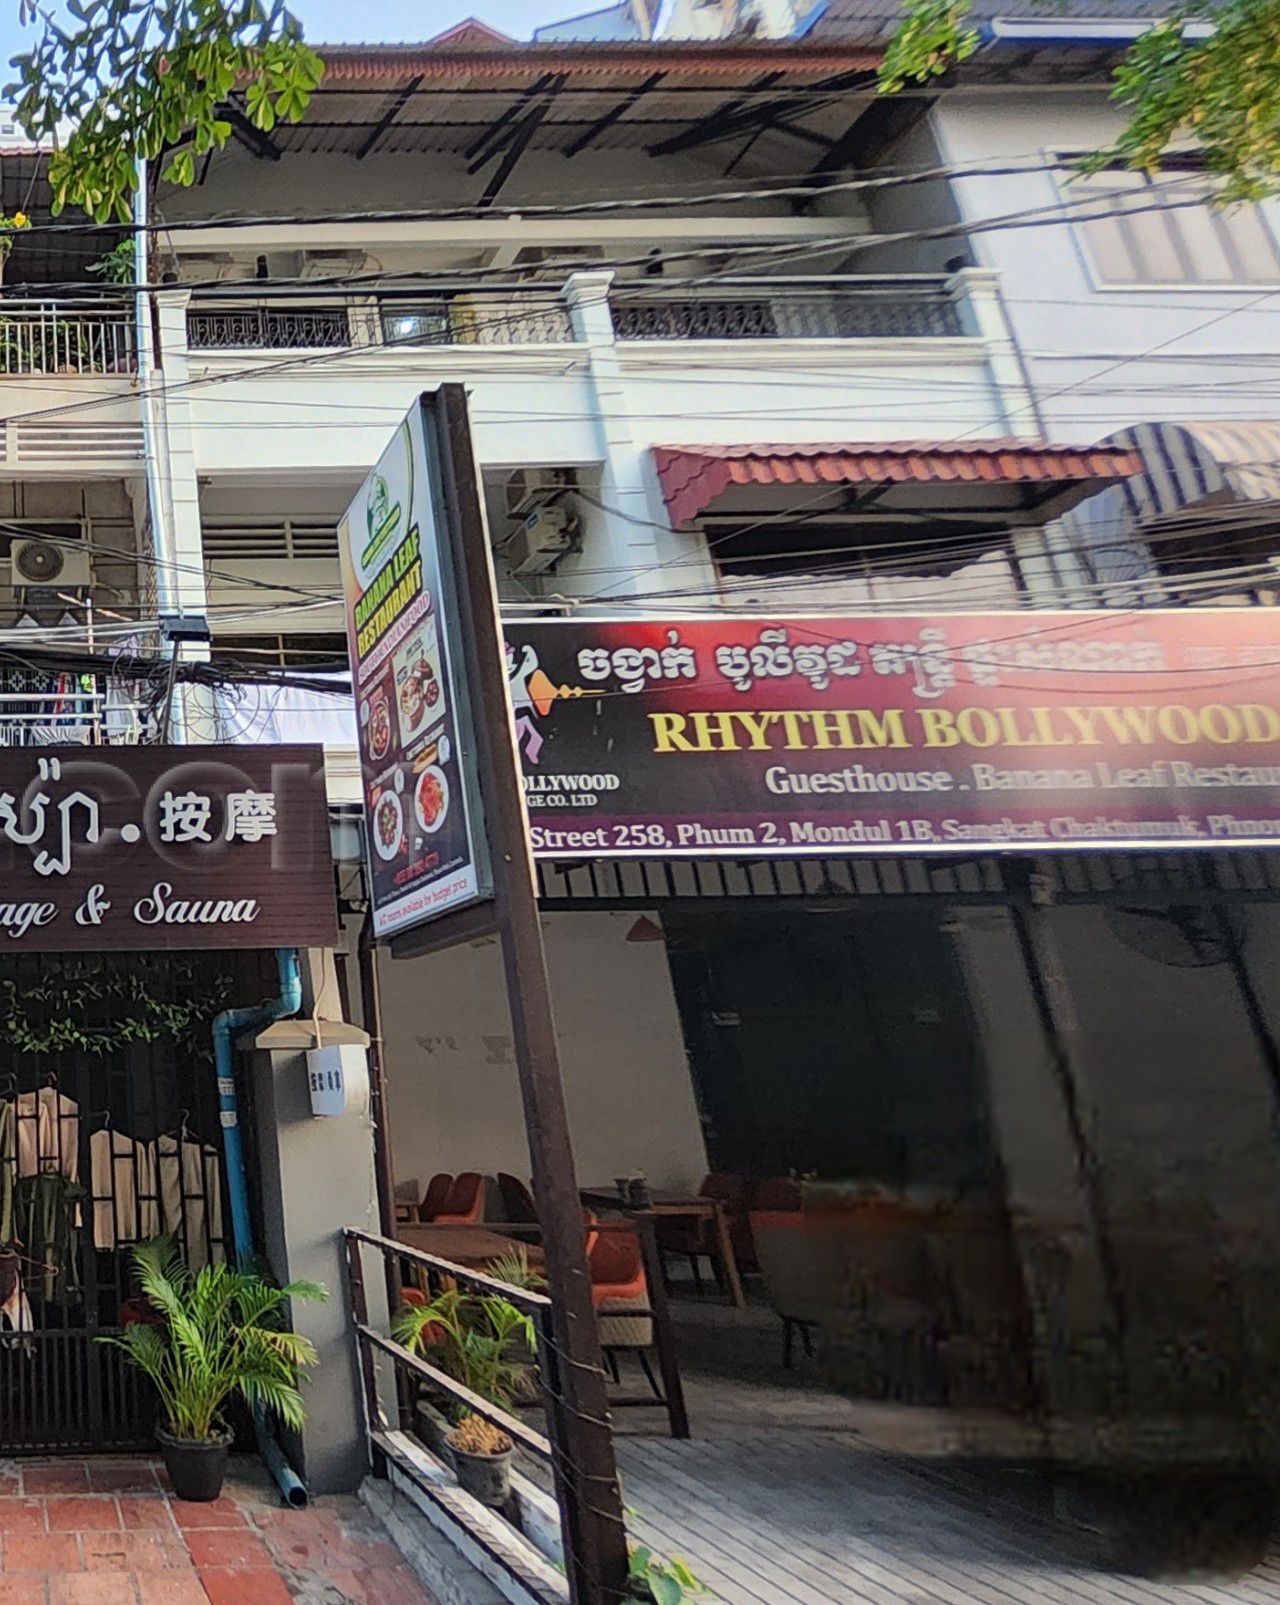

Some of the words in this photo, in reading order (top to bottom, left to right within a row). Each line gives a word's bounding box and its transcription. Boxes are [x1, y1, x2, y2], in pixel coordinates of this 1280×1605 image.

[355, 564, 394, 631] BANANA
[393, 528, 418, 580] LEAF
[358, 559, 421, 659] RESTAURANT
[648, 708, 912, 753] RHYTHM
[916, 703, 1280, 748] BOLLYWOOD
[570, 793, 599, 807] LTD
[765, 764, 952, 794] Guesthouse
[971, 763, 1096, 790] Banana
[158, 790, 278, 844] 按摩
[529, 826, 610, 849] Street
[612, 824, 673, 848] 258,
[677, 822, 756, 845] Phum
[759, 821, 786, 845] 2,
[789, 820, 892, 844] Mondul
[75, 883, 112, 926] &
[133, 882, 260, 926] Sauna
